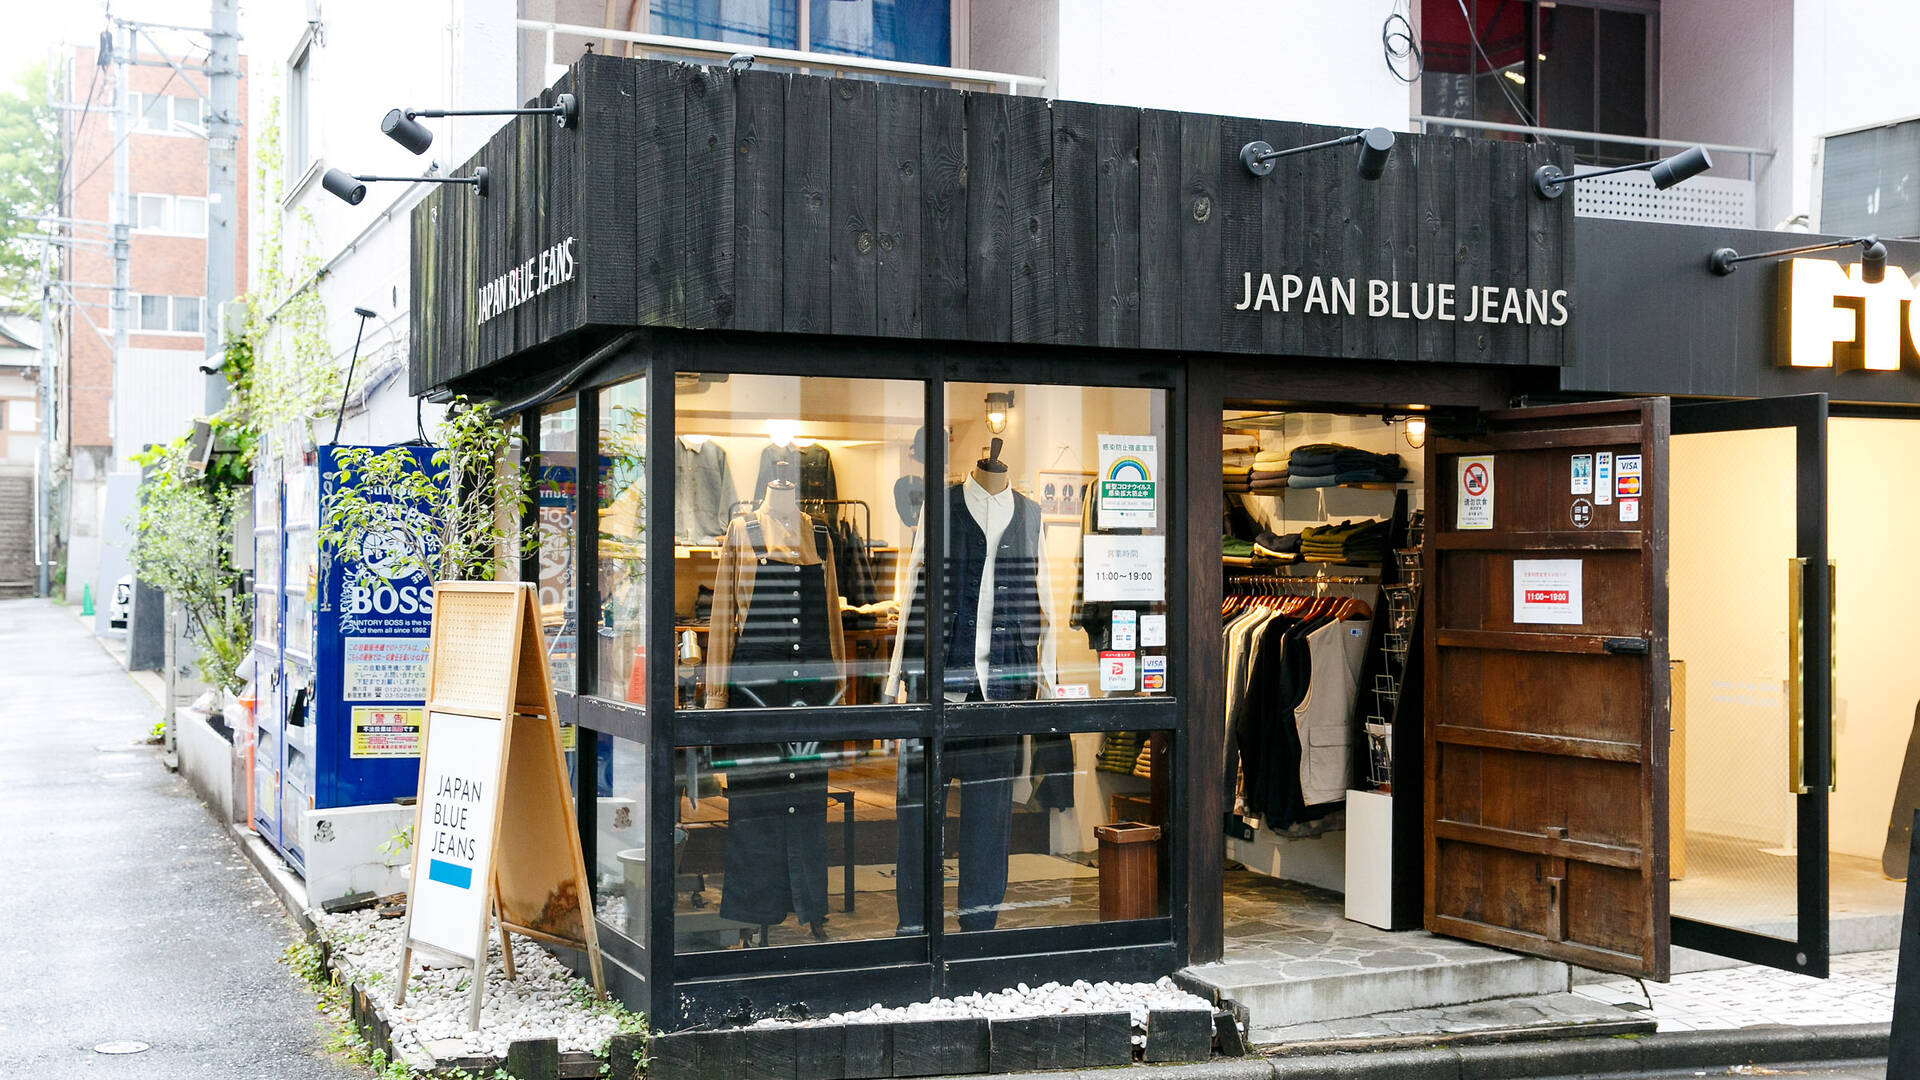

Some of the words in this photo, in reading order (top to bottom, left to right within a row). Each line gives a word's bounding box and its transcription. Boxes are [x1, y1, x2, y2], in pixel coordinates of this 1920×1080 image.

[478, 273, 507, 326] JAPAN
[509, 257, 536, 309] BLUE
[537, 236, 574, 295] JEANS
[1235, 271, 1356, 316] JAPAN
[1368, 279, 1456, 321] BLUE
[1463, 285, 1568, 327] JEANS
[1621, 461, 1638, 470] VISA
[351, 586, 433, 614] BOSS
[436, 774, 482, 802] JAPAN
[434, 802, 468, 830] BLUE
[431, 831, 476, 861] JEANS
